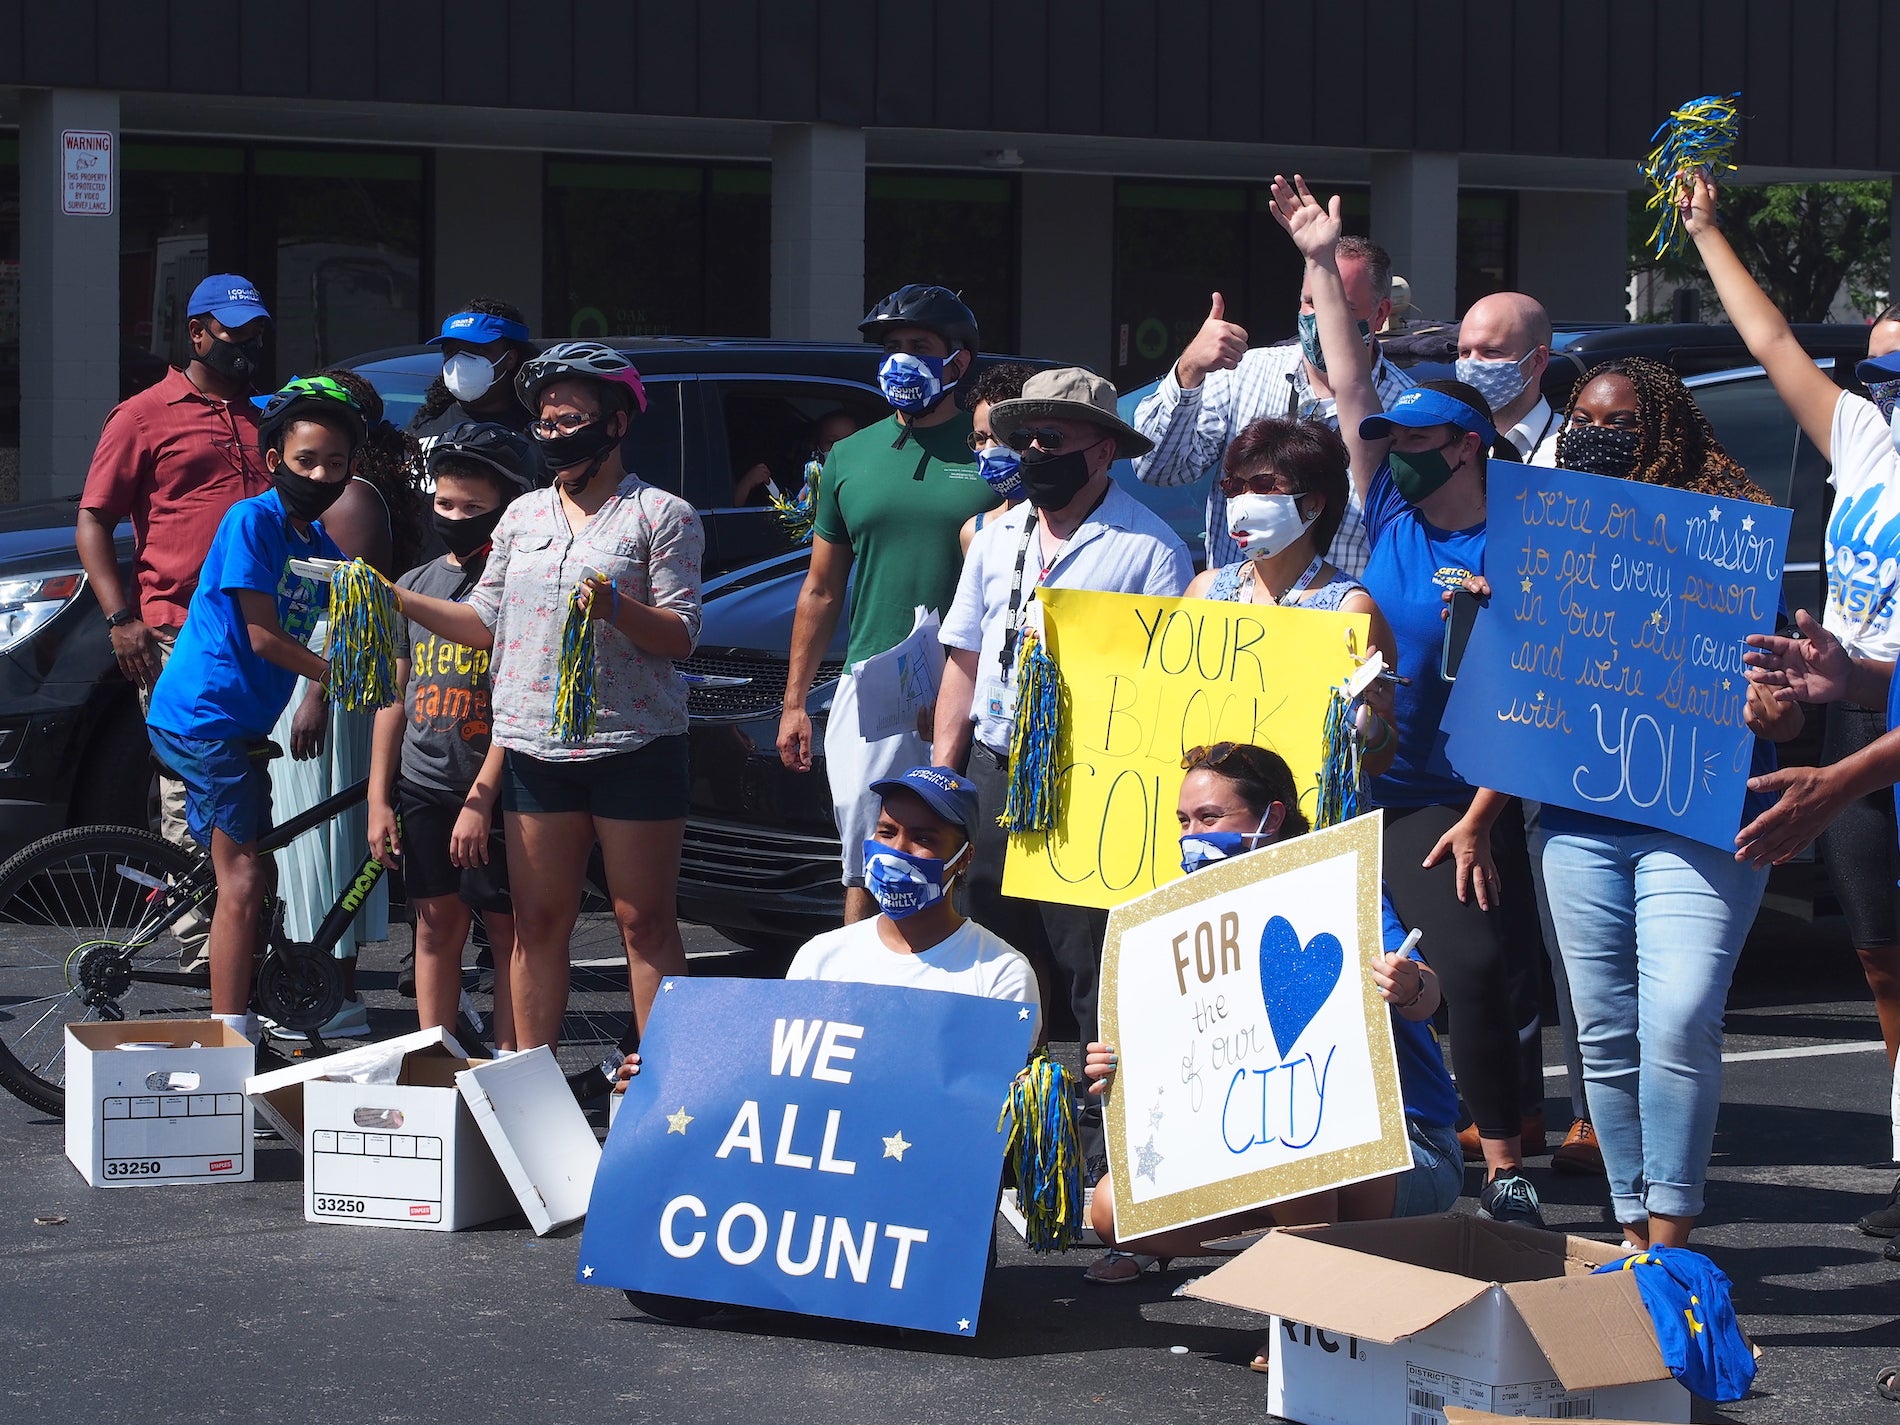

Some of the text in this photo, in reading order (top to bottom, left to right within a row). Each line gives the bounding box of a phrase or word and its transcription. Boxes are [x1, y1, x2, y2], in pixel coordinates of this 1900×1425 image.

[66, 136, 109, 151] WARNING
[67, 172, 108, 182] THIS PROPERTY
[69, 182, 106, 191] IS PROTECTED
[75, 192, 100, 201] BY VIDEO
[1438, 566, 1457, 576] GET
[1600, 504, 1641, 542] on
[1648, 513, 1678, 554] a
[1684, 514, 1779, 581] mission
[1516, 536, 1765, 635] to get every person
[1134, 607, 1266, 693] YOUR
[1511, 635, 1566, 682] and
[1575, 649, 1645, 697] we're
[1514, 588, 1768, 682] in our city count
[1497, 696, 1574, 735] with
[1573, 703, 1698, 817] YOU
[1171, 911, 1241, 996] FOR
[1192, 994, 1229, 1034] the
[770, 1017, 864, 1085] WE
[1181, 1024, 1265, 1113] of our
[1222, 1044, 1336, 1154] CITY
[107, 1161, 161, 1175] 33250
[714, 1099, 857, 1175] ALL
[317, 1198, 365, 1213] 33250
[658, 1194, 929, 1290] COUNT
[1409, 1367, 1446, 1381] DISTRICT
